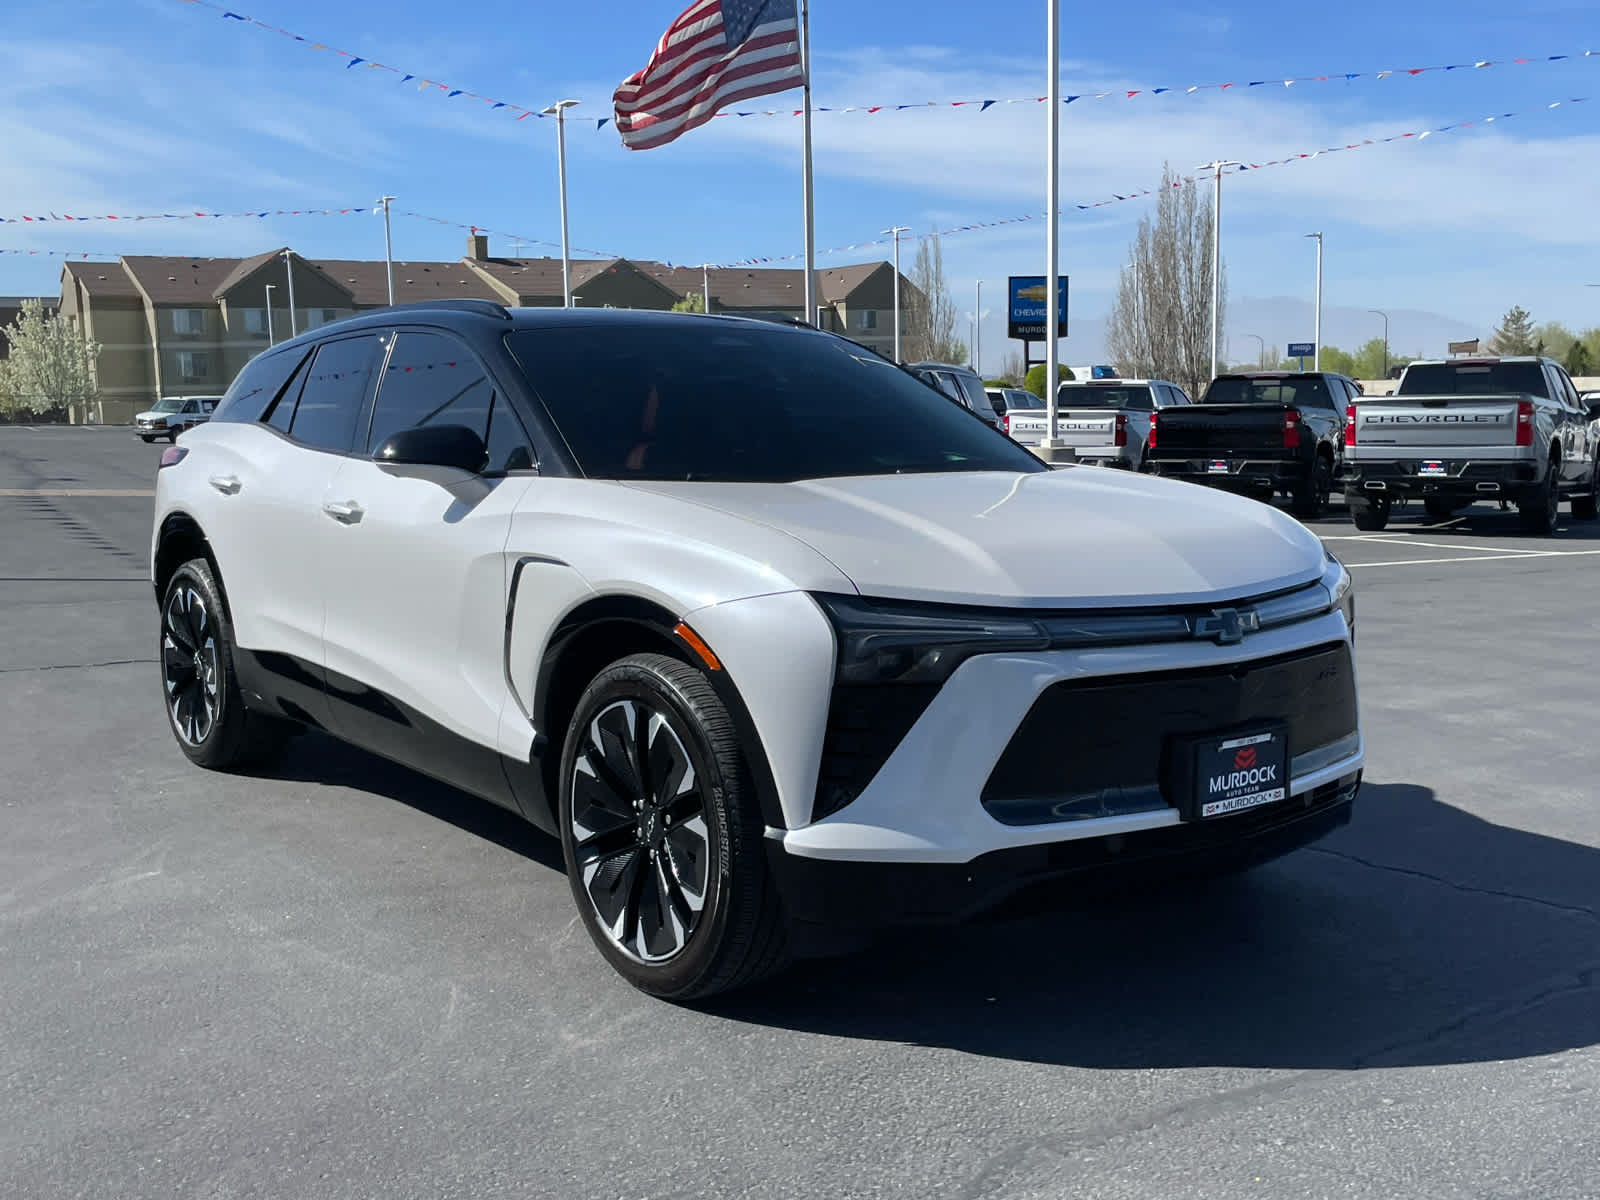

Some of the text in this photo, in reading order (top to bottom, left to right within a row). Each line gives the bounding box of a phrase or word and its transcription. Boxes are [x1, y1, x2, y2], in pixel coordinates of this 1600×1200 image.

[1014, 308, 1062, 317] CHEVROT
[1366, 415, 1504, 424] CHEVROLET
[1209, 765, 1276, 793] MURDOCK
[1226, 785, 1260, 797] AUTO TEAM
[1222, 793, 1267, 812] MURDOCK
